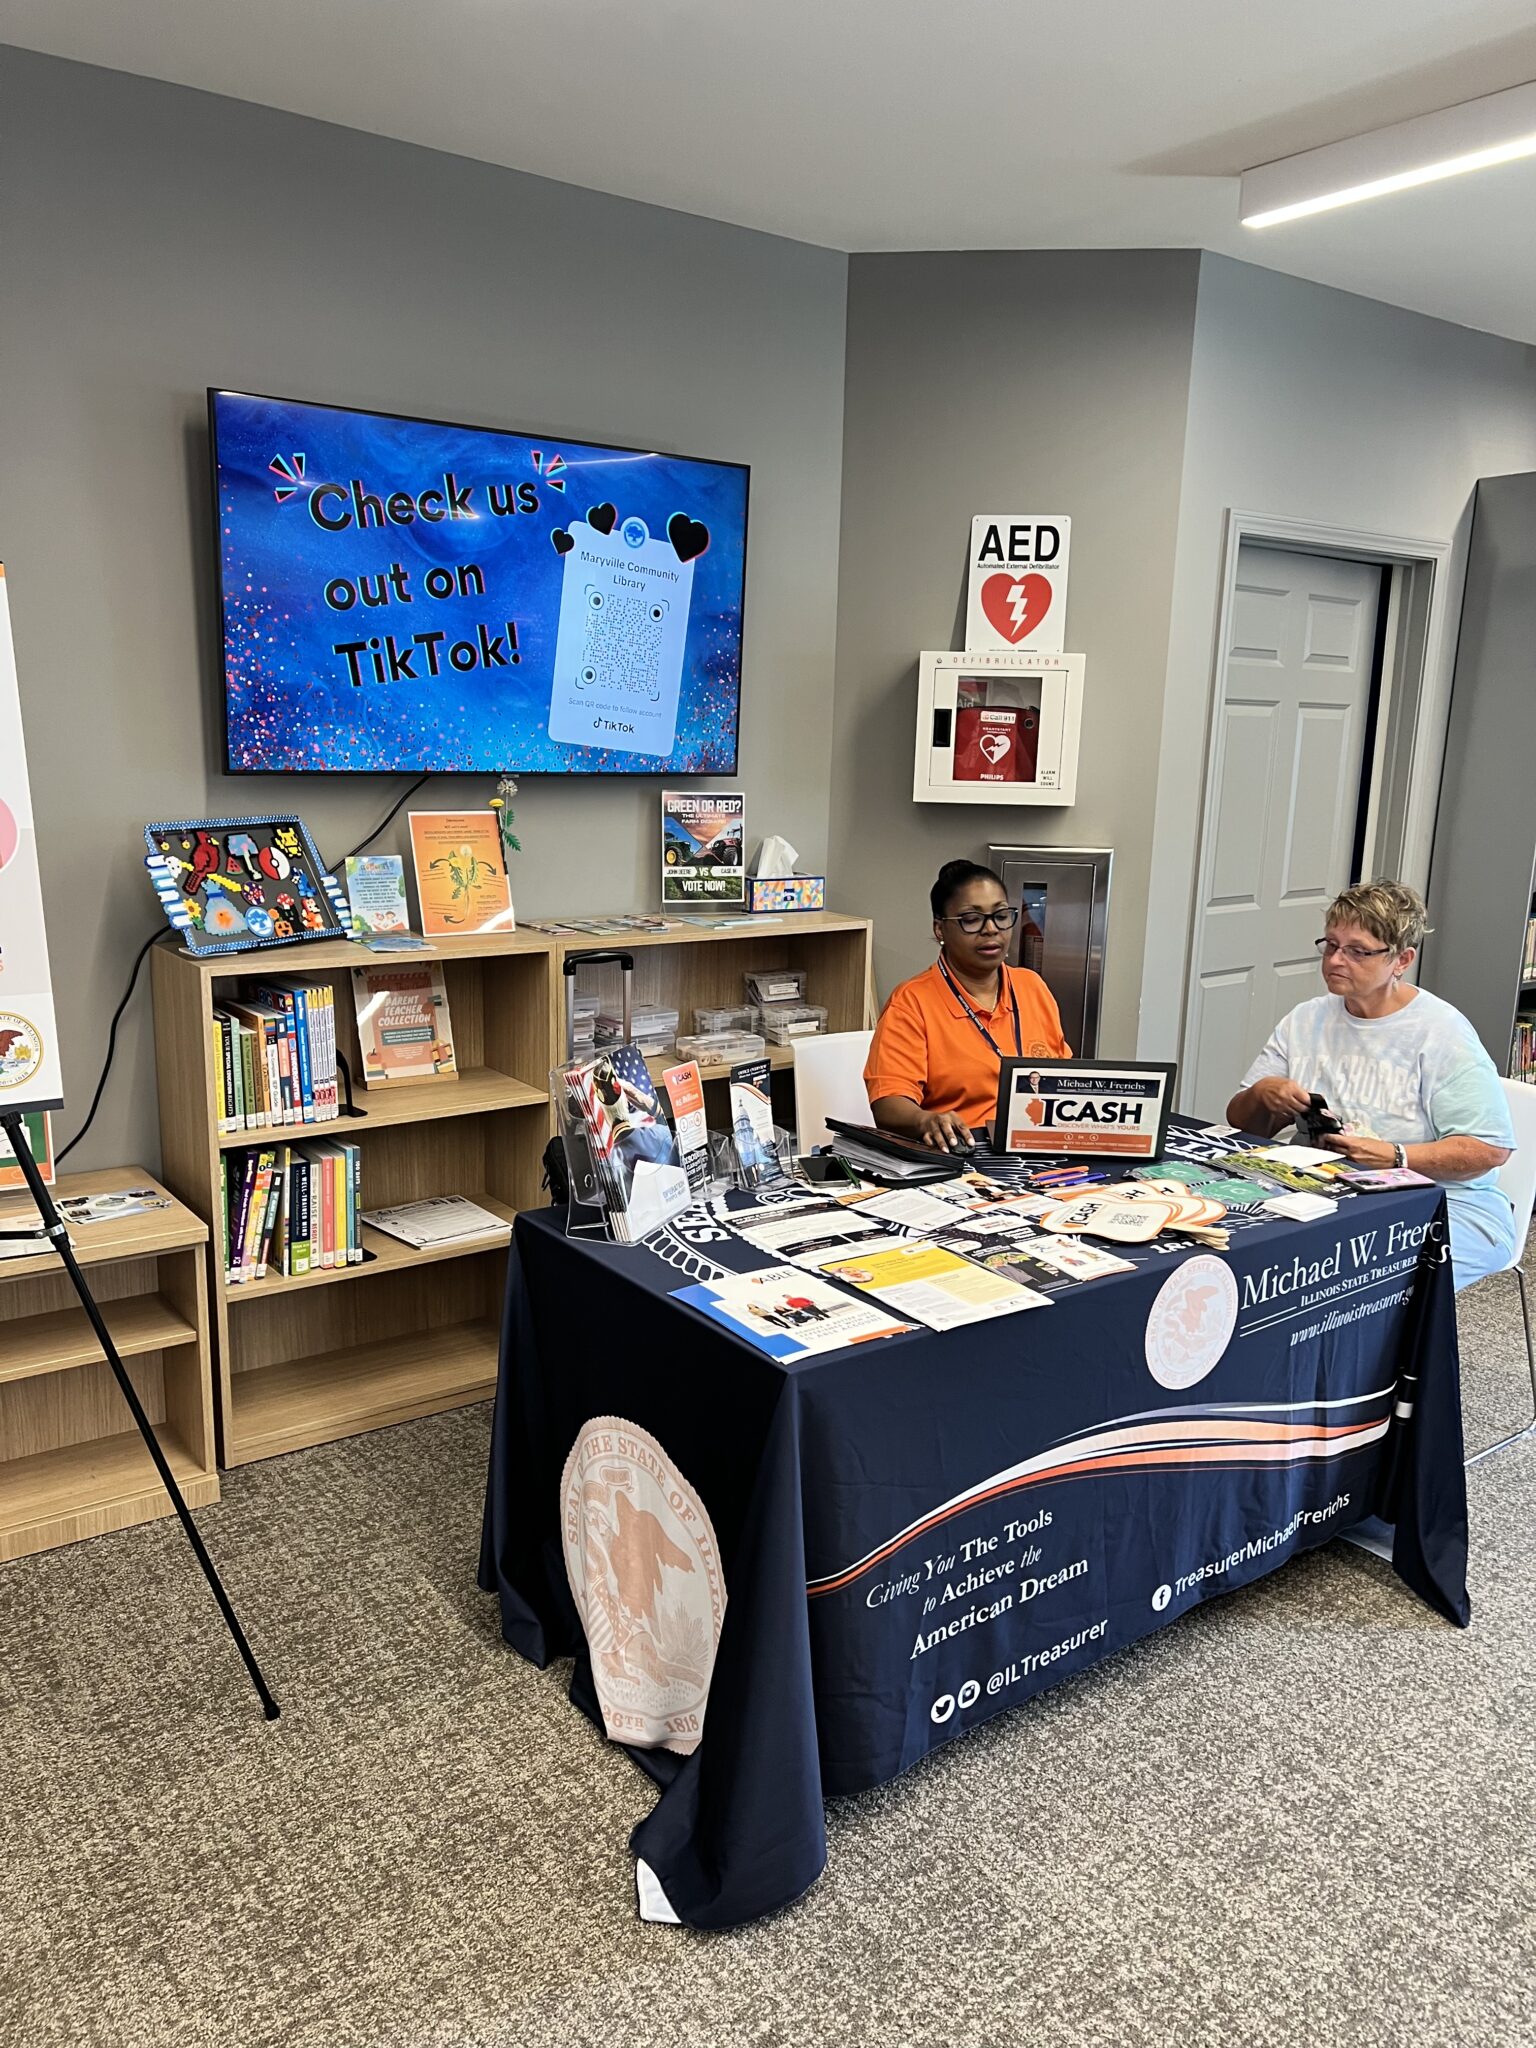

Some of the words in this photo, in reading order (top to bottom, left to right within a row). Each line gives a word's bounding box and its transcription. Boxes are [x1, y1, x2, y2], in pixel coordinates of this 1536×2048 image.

[308, 473, 475, 531] Check
[489, 481, 539, 516] us
[978, 524, 1060, 562] AED
[580, 551, 625, 568] Maryville
[627, 562, 679, 583] Community
[324, 564, 412, 611] out
[424, 563, 485, 600] on
[613, 575, 646, 592] Library
[333, 621, 521, 687] TikTok!
[953, 656, 1060, 666] DEFIBRILLATOR
[568, 698, 584, 706] Scan
[585, 700, 595, 708] QR
[595, 703, 611, 711] code
[620, 706, 637, 715] follow
[603, 720, 634, 733] TikTok
[980, 773, 1004, 781] PHILIPS
[667, 799, 699, 813] GREEN
[701, 799, 715, 813] OR
[716, 799, 741, 813] RED?
[699, 866, 709, 876] VS
[682, 880, 703, 891] VOTE
[704, 880, 726, 891] NOW!
[384, 1004, 423, 1016] TEACHER
[385, 994, 419, 1006] PARENT
[378, 1013, 431, 1027] COLLECTION
[290, 1051, 300, 1102] KINDERGARTEN
[1057, 1079, 1092, 1088] Michael
[1095, 1080, 1106, 1089] W.
[1109, 1081, 1146, 1090] Frerichs
[1039, 1099, 1143, 1127] ICASH
[1065, 1202, 1102, 1226] ICASH
[758, 1270, 799, 1284] ABLE
[1241, 1241, 1341, 1310] Michael
[1350, 1230, 1378, 1268] W.
[1300, 1285, 1341, 1308] ILLINOIS
[1341, 1273, 1370, 1293] STATE
[1370, 1255, 1418, 1281] TREASURER
[567, 1486, 581, 1546] SEAL
[584, 1434, 613, 1454] THE
[618, 1436, 666, 1489] STATE
[669, 1489, 698, 1524] OF
[1174, 1493, 1351, 1597] TreasurerMichaelFrerichs
[866, 1571, 920, 1608] Giving
[924, 1553, 956, 1581] You
[960, 1536, 999, 1563] The
[1003, 1509, 1053, 1543] Tools
[922, 1596, 937, 1616] to
[940, 1559, 1015, 1606] Achieve
[1020, 1545, 1042, 1569] the
[909, 1594, 1013, 1660] American
[1019, 1559, 1089, 1604] Dream
[986, 1618, 1108, 1695] @ILTreasurer
[665, 1713, 699, 1734] 1818
